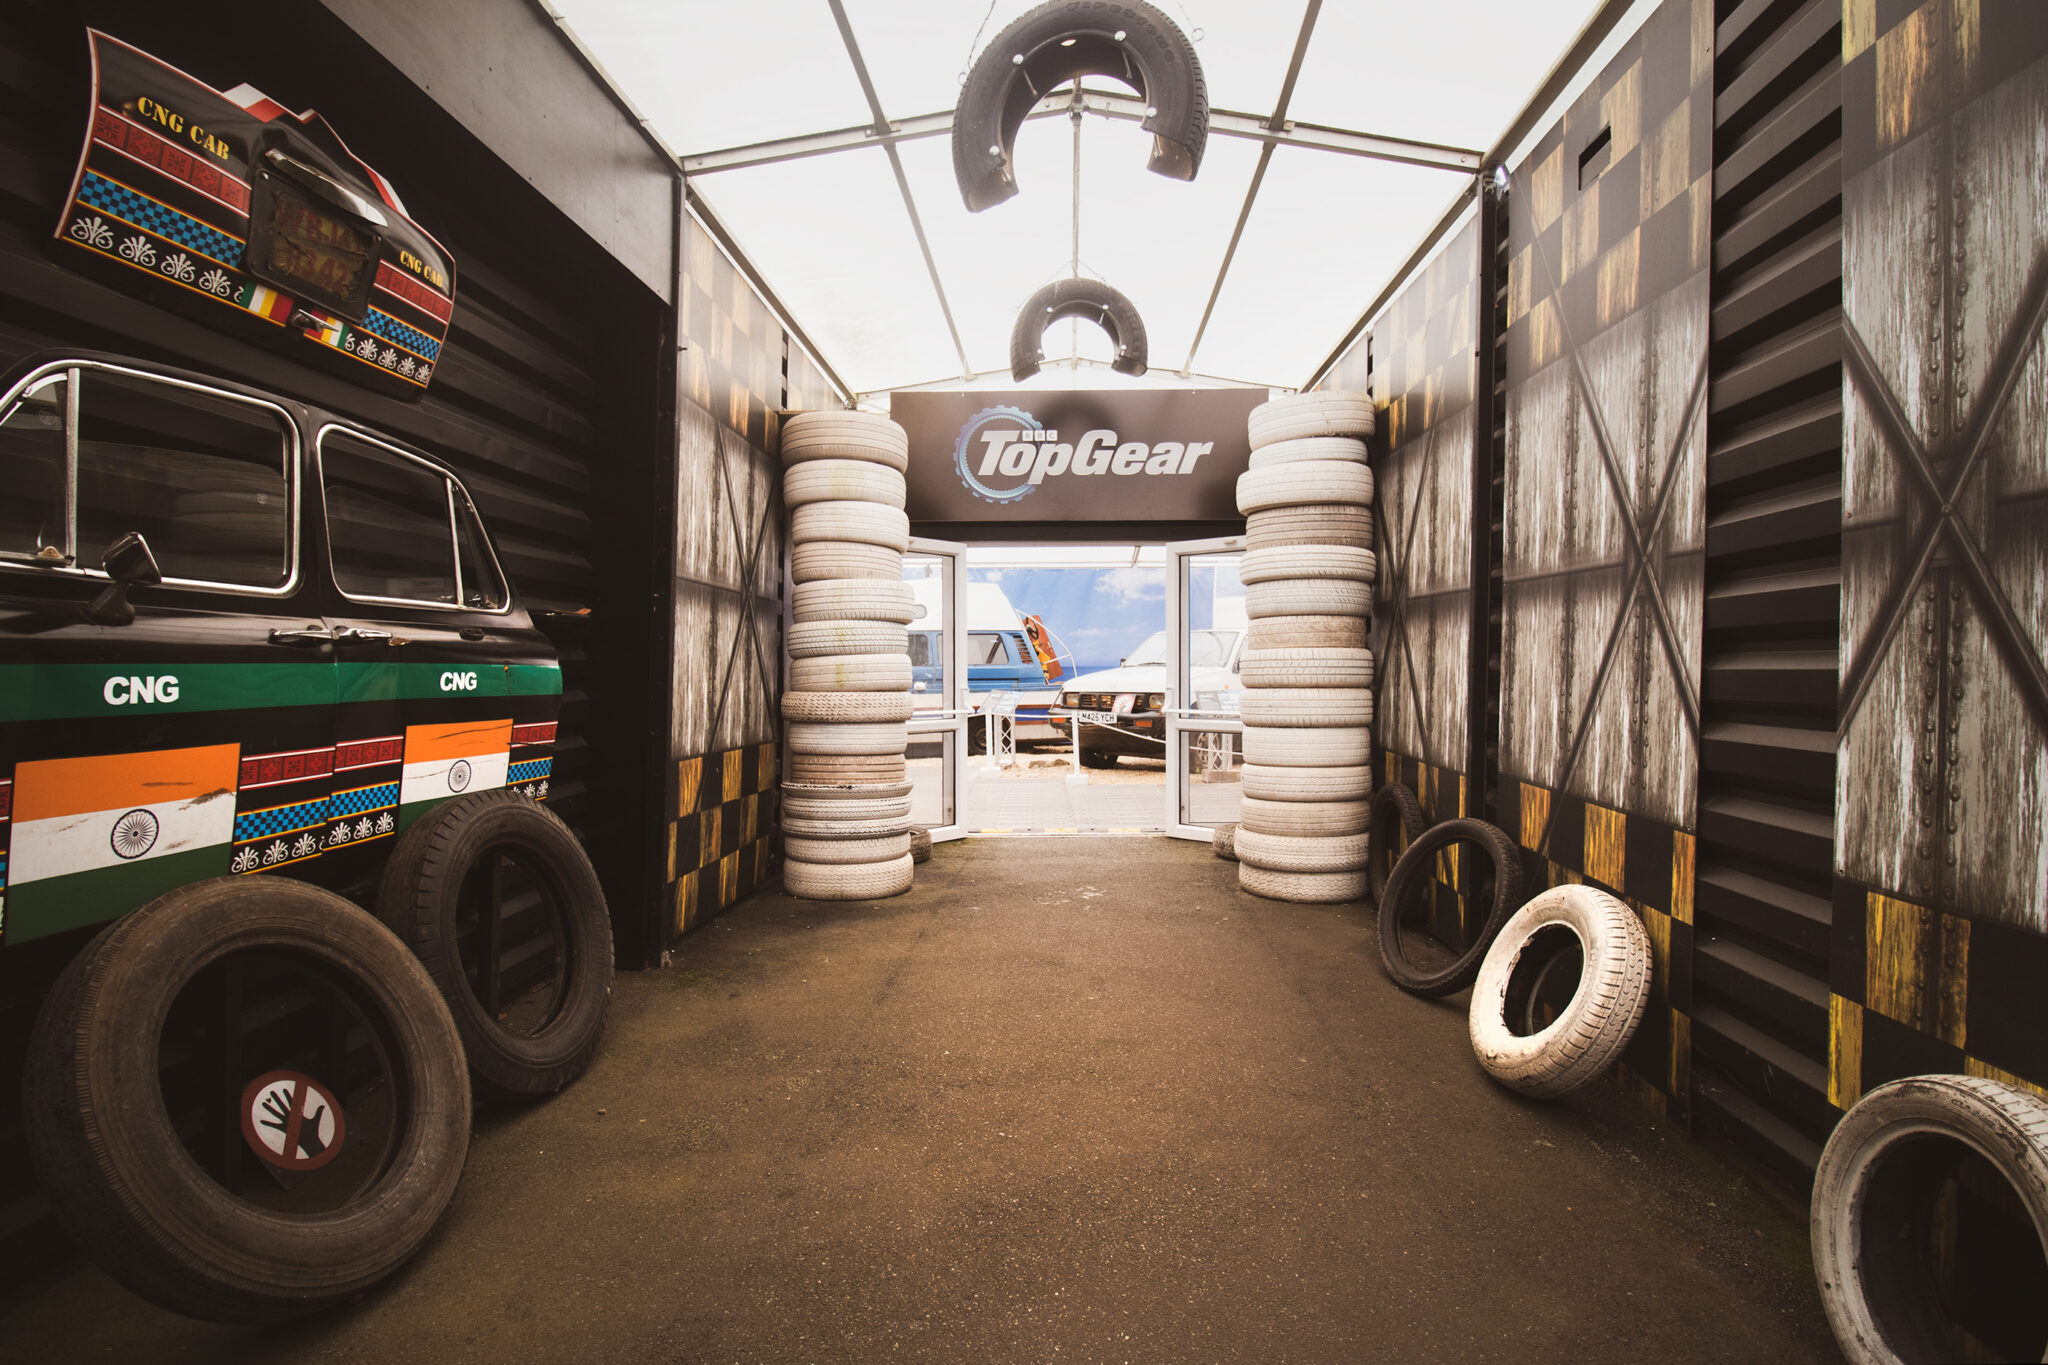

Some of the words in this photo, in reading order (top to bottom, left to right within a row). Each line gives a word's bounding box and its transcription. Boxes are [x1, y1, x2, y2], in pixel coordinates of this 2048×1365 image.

[138, 96, 184, 133] CNG
[190, 125, 230, 160] CAB
[400, 250, 422, 273] CNG
[423, 265, 443, 287] CAB
[1022, 430, 1058, 442] BBC
[103, 675, 180, 706] CNG
[440, 671, 478, 691] CNG
